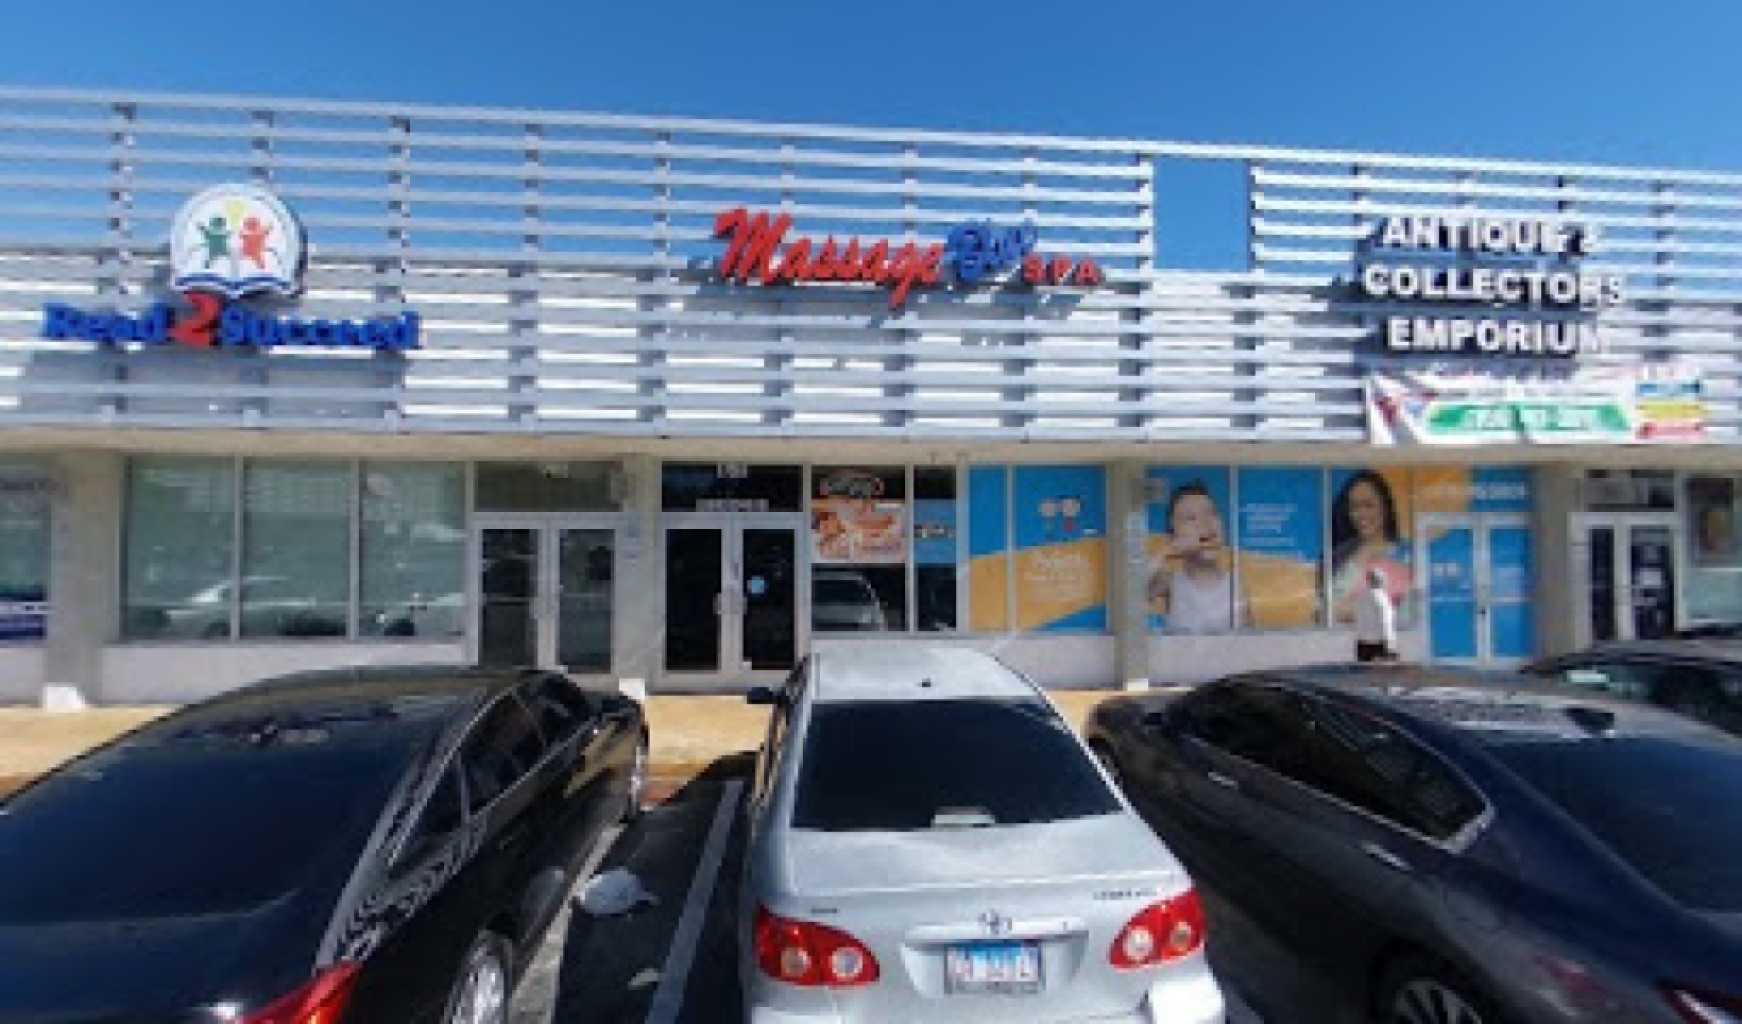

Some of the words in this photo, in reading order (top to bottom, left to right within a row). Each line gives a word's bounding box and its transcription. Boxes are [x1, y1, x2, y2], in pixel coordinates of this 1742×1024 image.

[713, 206, 945, 308] Massage
[1022, 252, 1101, 285] SPA
[1364, 262, 1626, 312] COLLECTORS
[42, 301, 171, 340] Read
[167, 290, 221, 348] 2
[220, 306, 421, 348] Succeed
[1386, 315, 1608, 354] EMPORIUM
